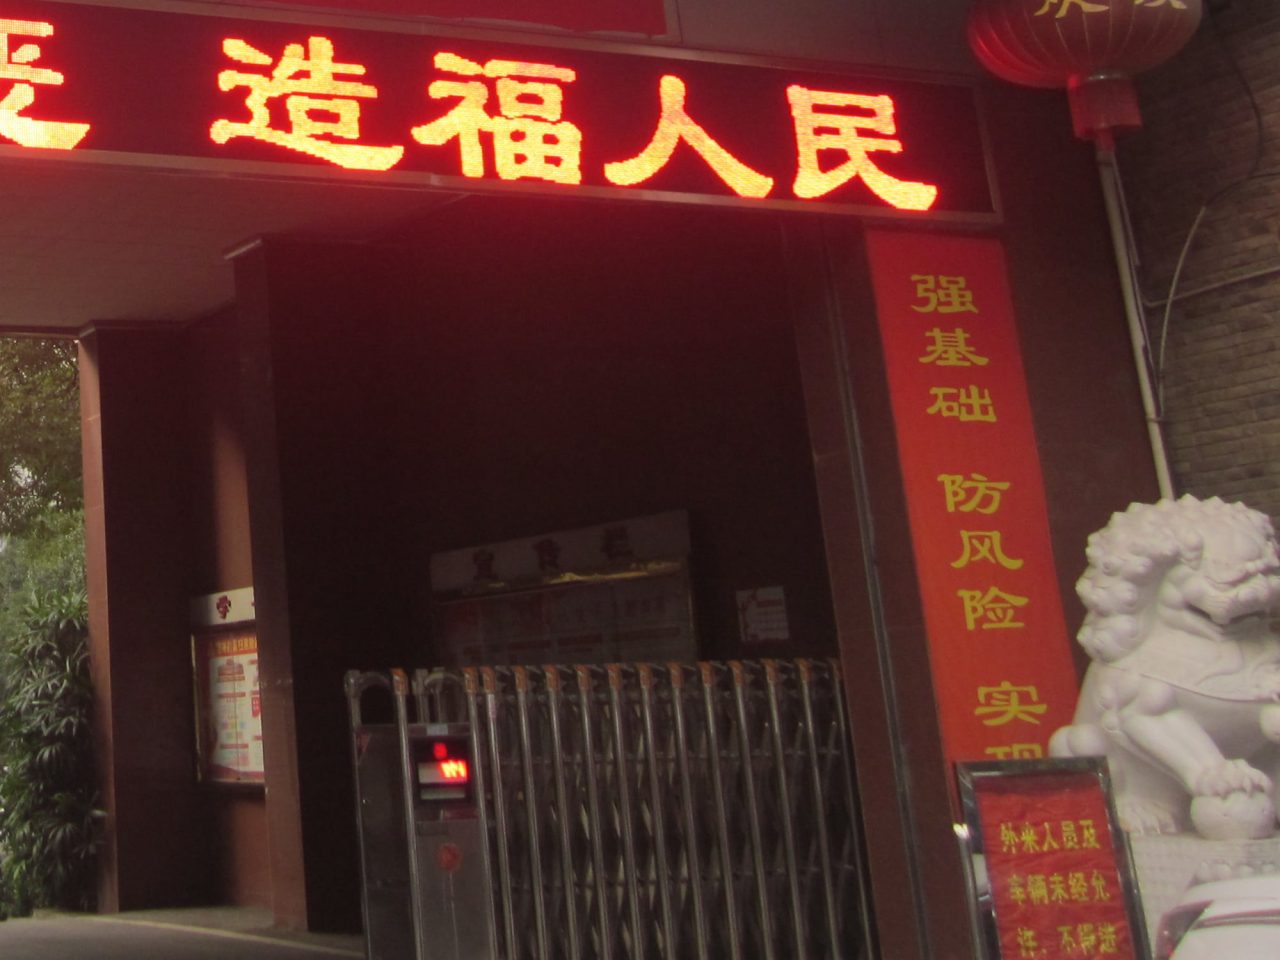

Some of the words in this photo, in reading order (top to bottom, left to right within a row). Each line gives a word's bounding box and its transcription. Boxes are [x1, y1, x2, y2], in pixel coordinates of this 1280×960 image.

[209, 36, 938, 211] 造福人民
[910, 273, 998, 423] 强基础
[937, 473, 1030, 632] 防风险
[1000, 819, 1100, 855] 外来人员及
[1008, 869, 1111, 906] 车辆未经允
